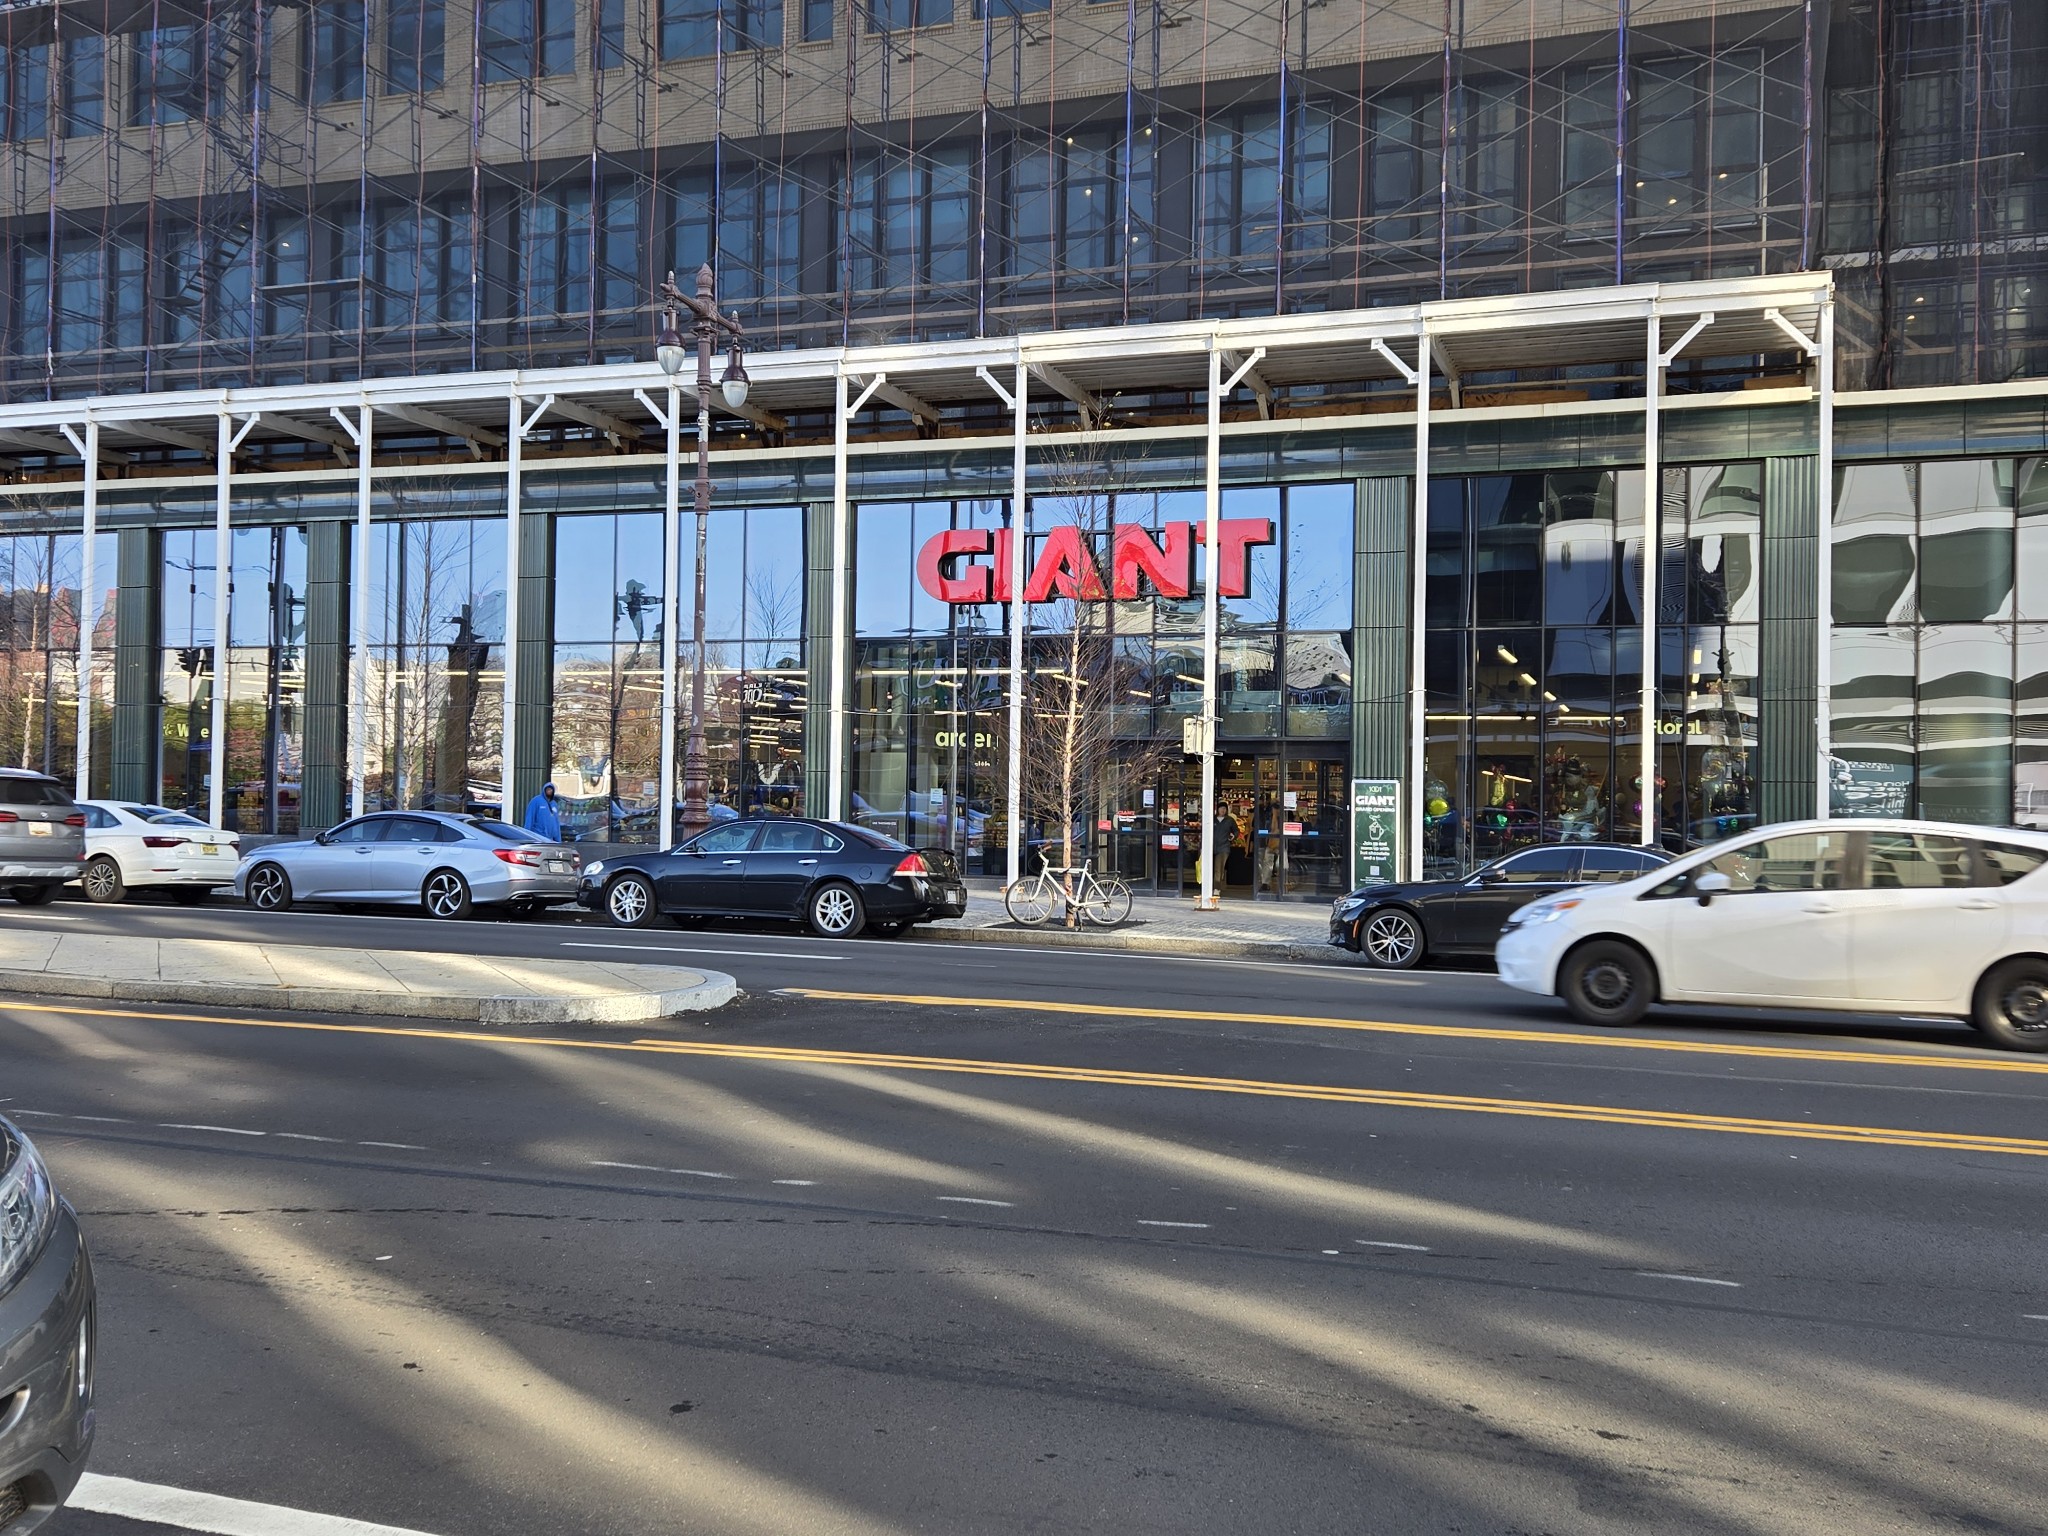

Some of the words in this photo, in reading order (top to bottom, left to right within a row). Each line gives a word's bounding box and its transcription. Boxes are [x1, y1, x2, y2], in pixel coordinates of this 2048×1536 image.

[916, 518, 1275, 604] GIANT
[177, 723, 210, 738] We
[1355, 795, 1396, 806] GIANT
